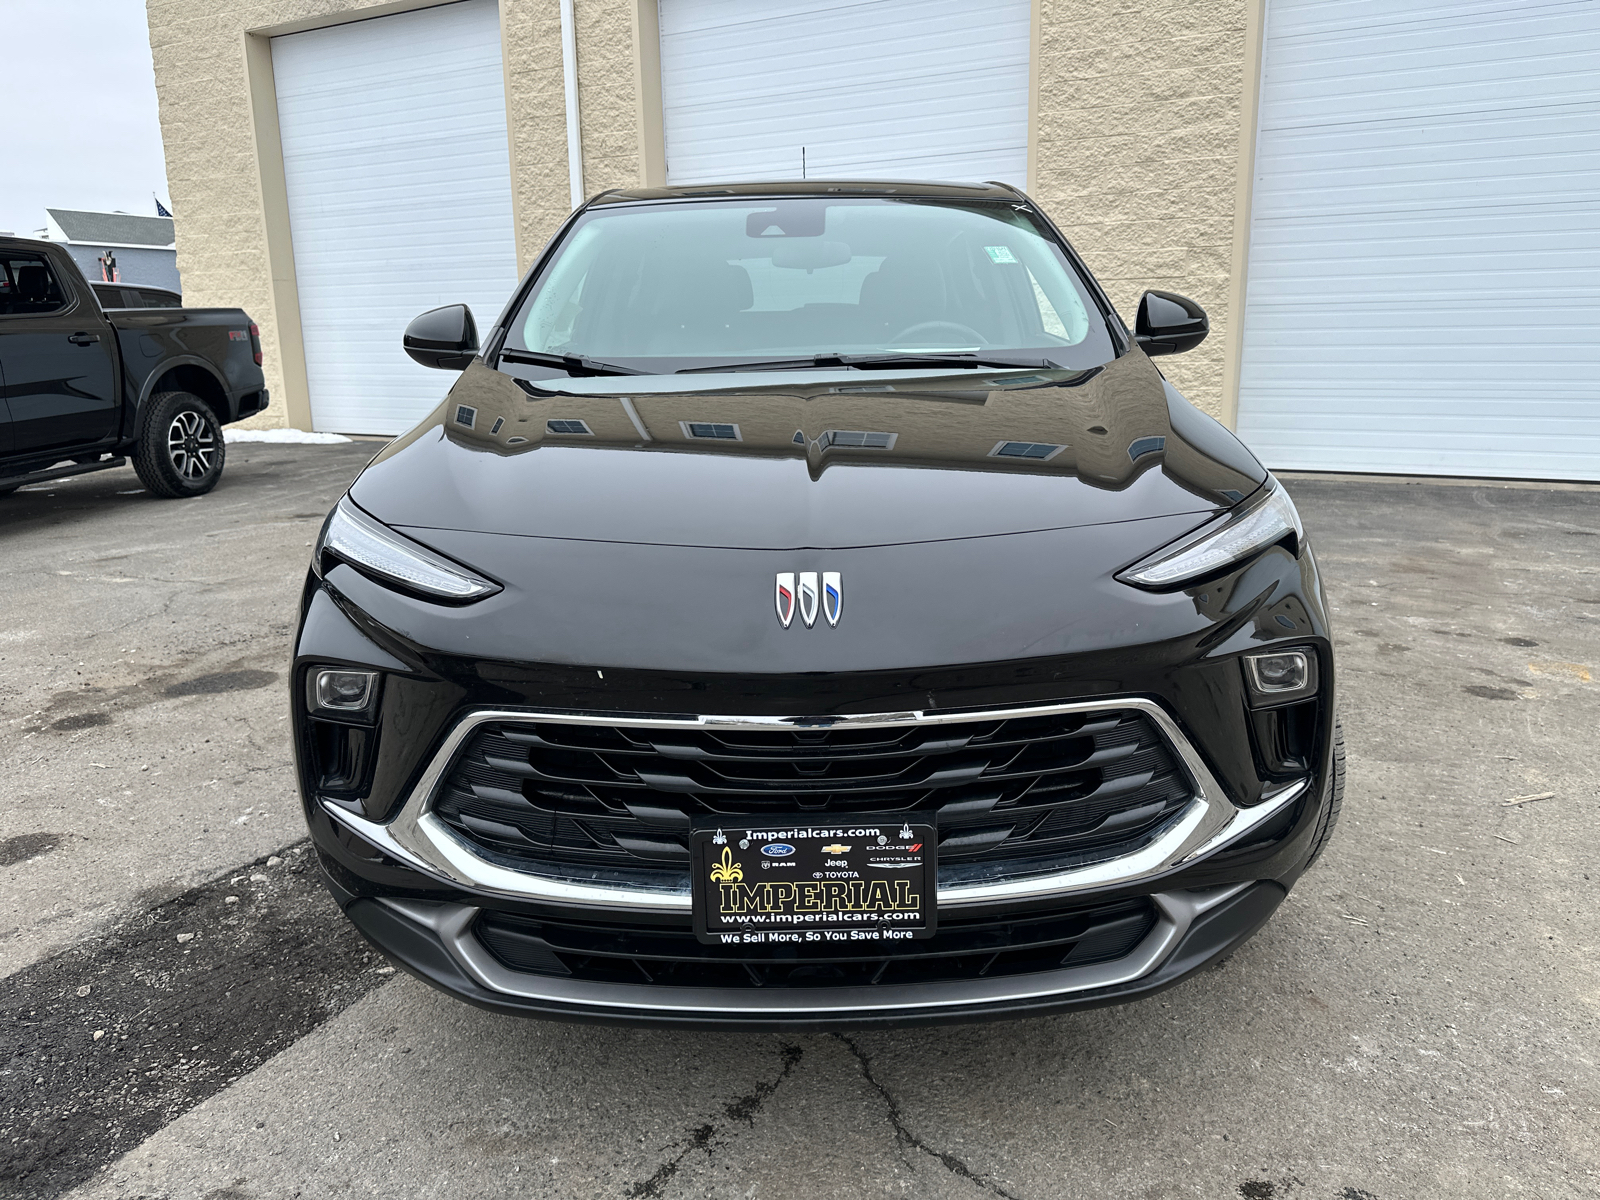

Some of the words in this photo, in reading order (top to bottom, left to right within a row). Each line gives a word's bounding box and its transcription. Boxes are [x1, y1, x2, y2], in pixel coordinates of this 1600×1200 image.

[746, 828, 880, 842] Imperialcars.com
[768, 846, 788, 855] Ford
[825, 859, 848, 868] Jeep
[720, 881, 920, 913] IMPERIAL
[720, 912, 920, 924] www.imperialcars.com
[721, 934, 740, 944] We
[743, 934, 765, 943] Sell
[769, 933, 803, 943] More,
[806, 932, 821, 941] So
[824, 932, 847, 941] You
[852, 931, 880, 940] Save
[883, 930, 913, 939] More
